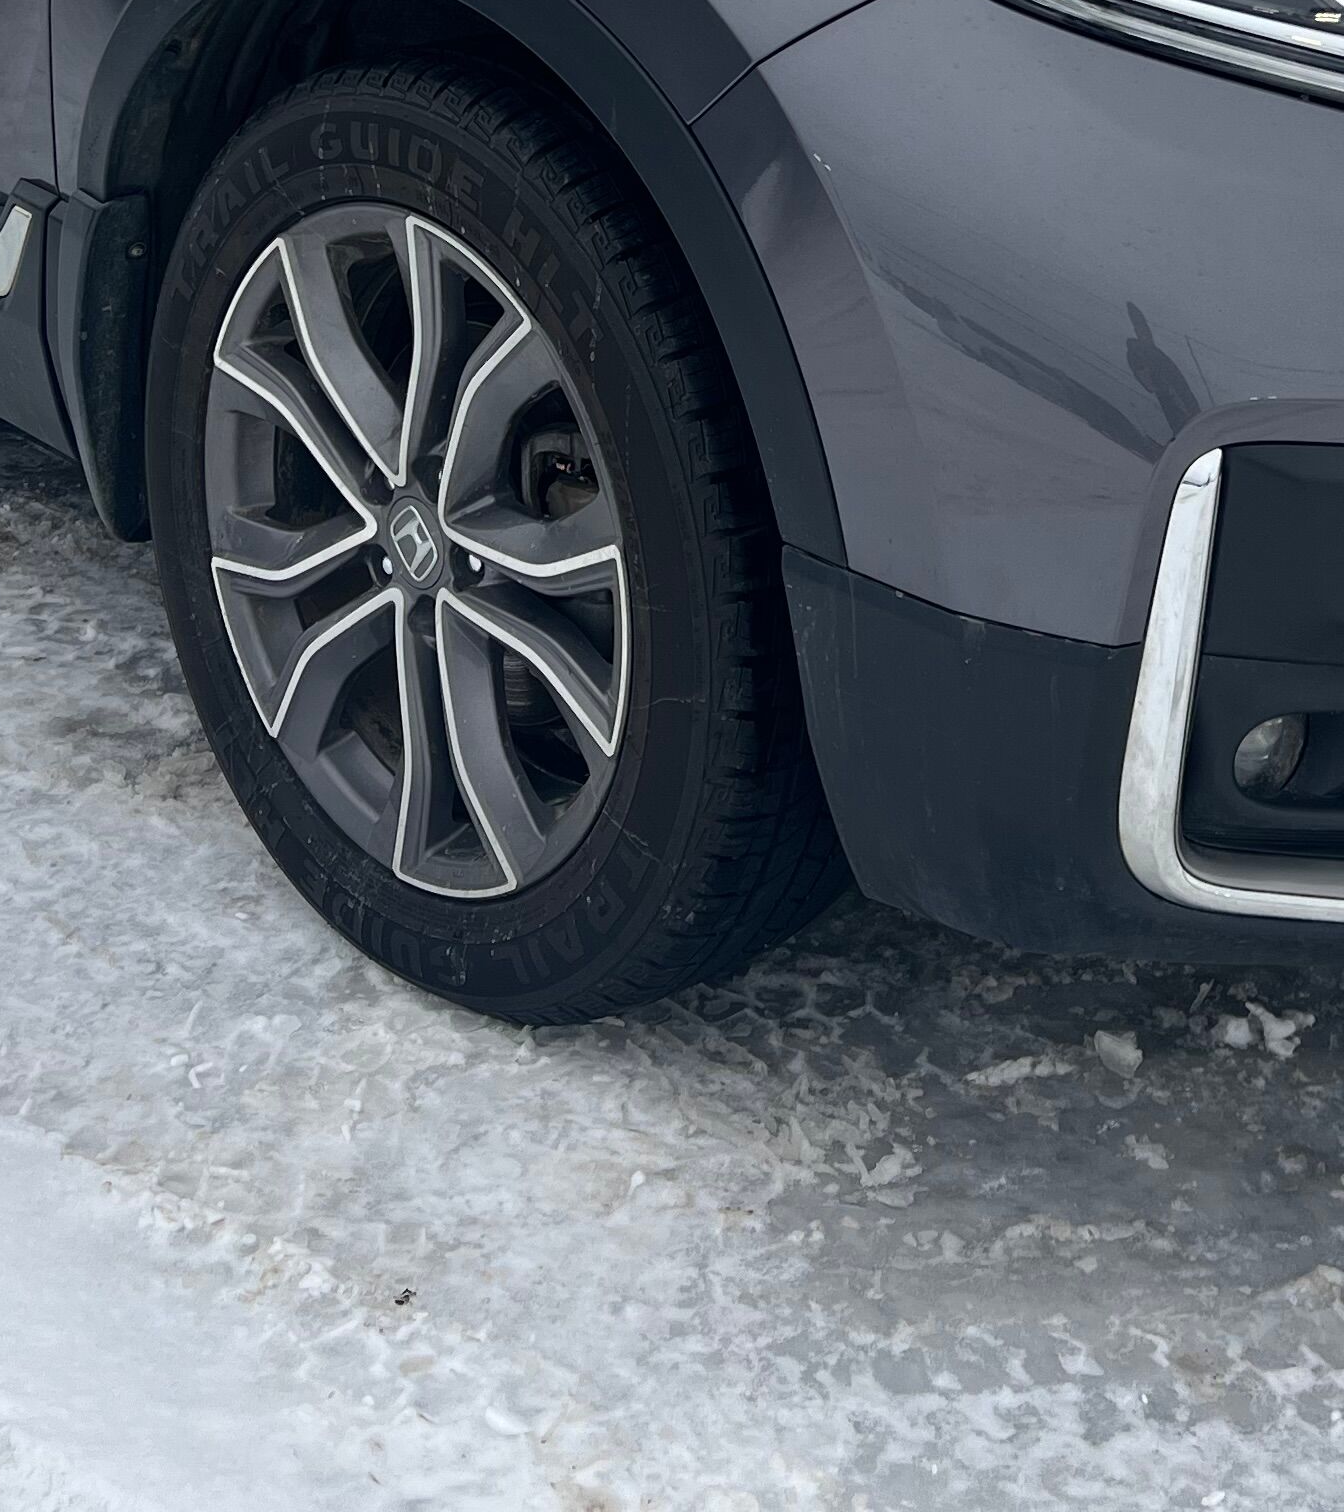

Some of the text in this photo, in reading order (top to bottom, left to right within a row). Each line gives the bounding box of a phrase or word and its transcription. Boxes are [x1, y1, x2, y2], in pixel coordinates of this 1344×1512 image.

[172, 145, 291, 302] TRAIL
[309, 120, 487, 213] GUIDE
[498, 846, 655, 986] TRAIL
